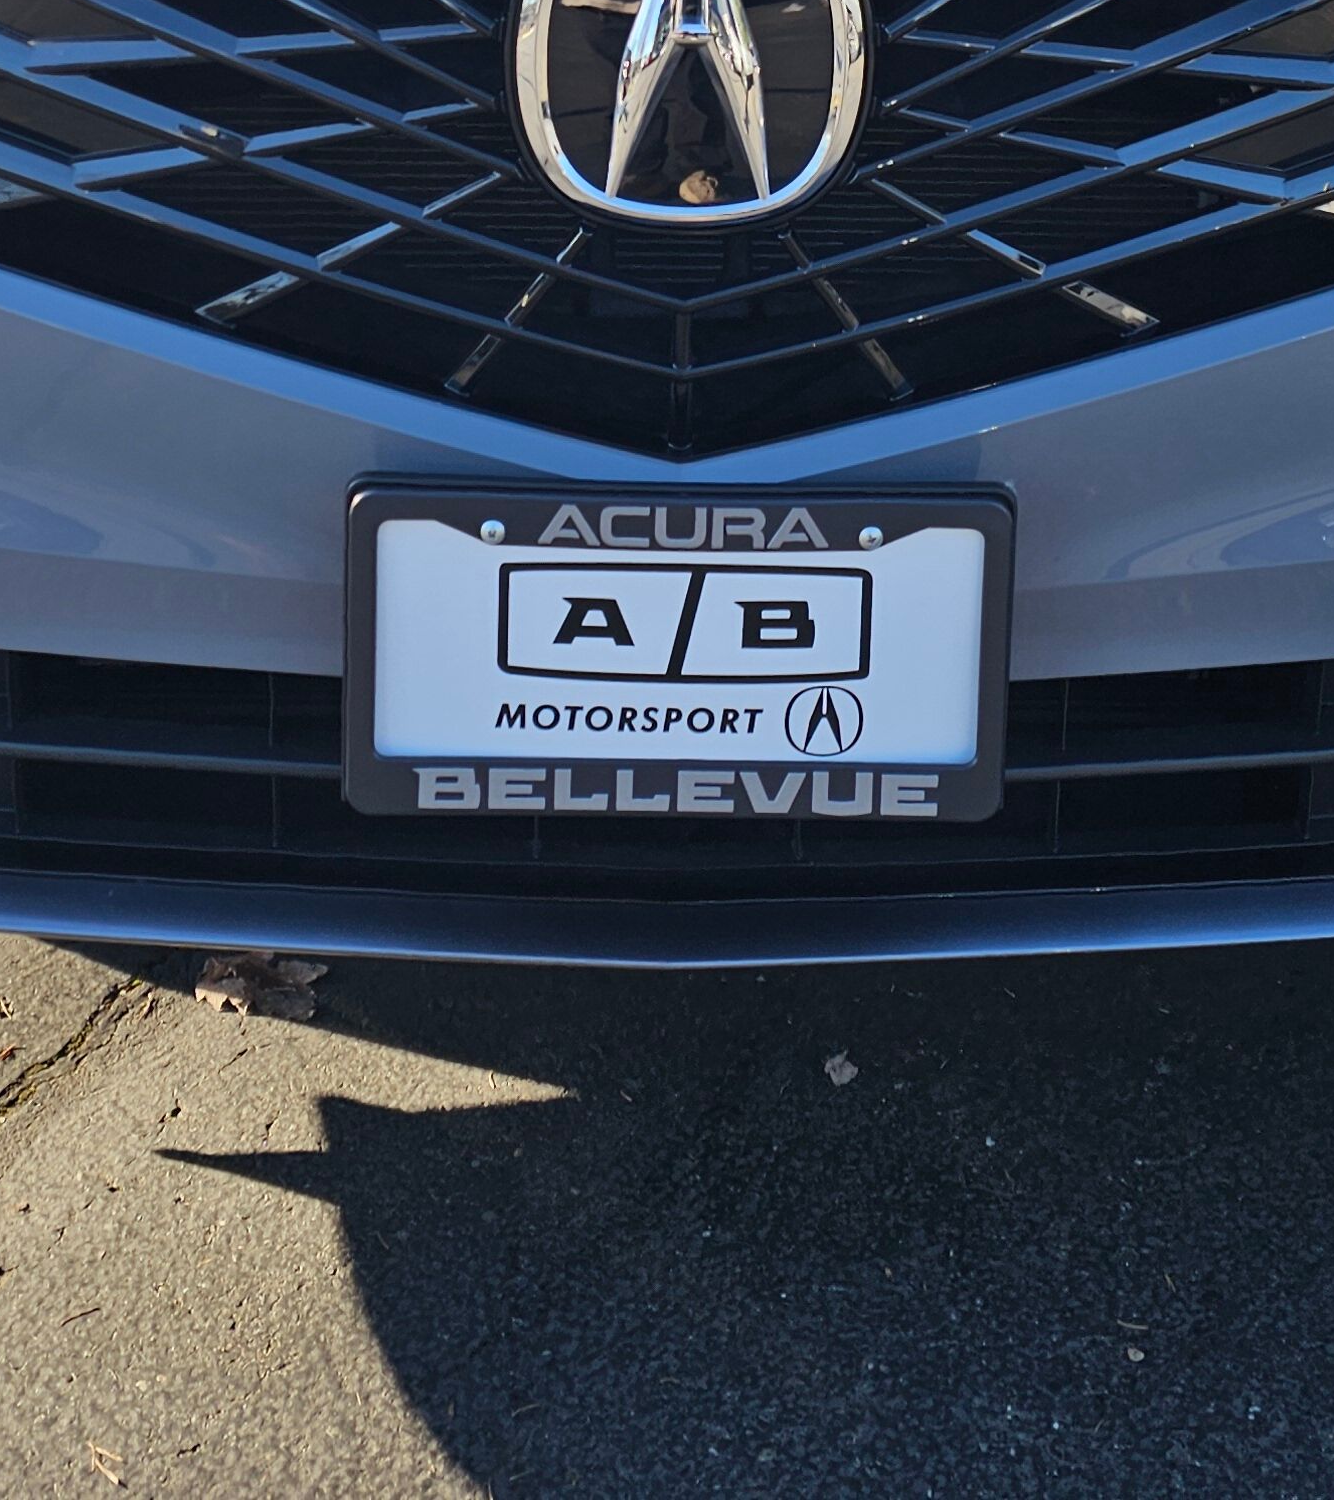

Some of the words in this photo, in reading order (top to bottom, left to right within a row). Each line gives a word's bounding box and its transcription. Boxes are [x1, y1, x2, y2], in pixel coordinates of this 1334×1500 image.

[537, 504, 830, 551] ACURA
[552, 596, 635, 647] A
[733, 600, 816, 649] B
[494, 702, 765, 735] MOTORSPORT
[412, 766, 940, 818] BELLEVUE
